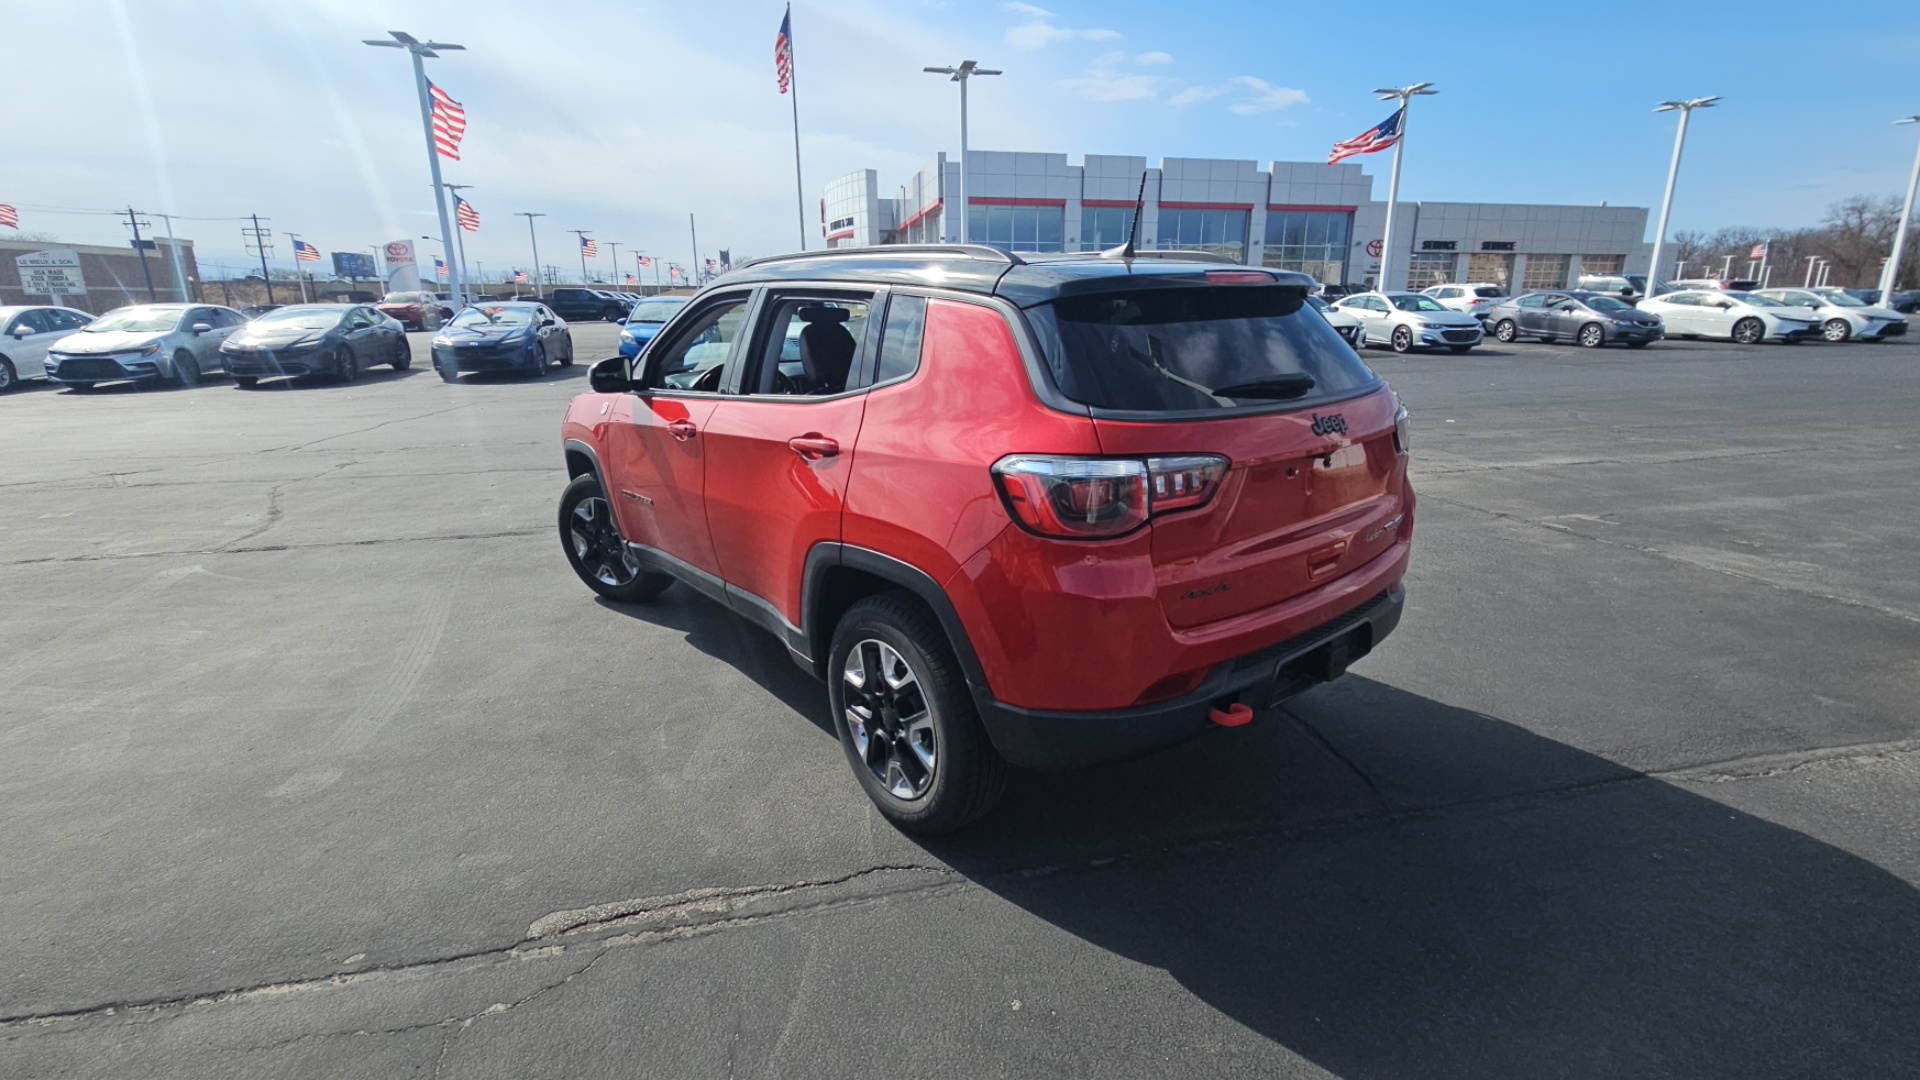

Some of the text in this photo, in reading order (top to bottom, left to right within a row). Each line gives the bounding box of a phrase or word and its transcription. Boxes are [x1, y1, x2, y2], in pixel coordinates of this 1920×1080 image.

[1421, 240, 1458, 250] SERVICE
[1480, 241, 1517, 251] SERVICE
[1311, 413, 1348, 437] Jeep
